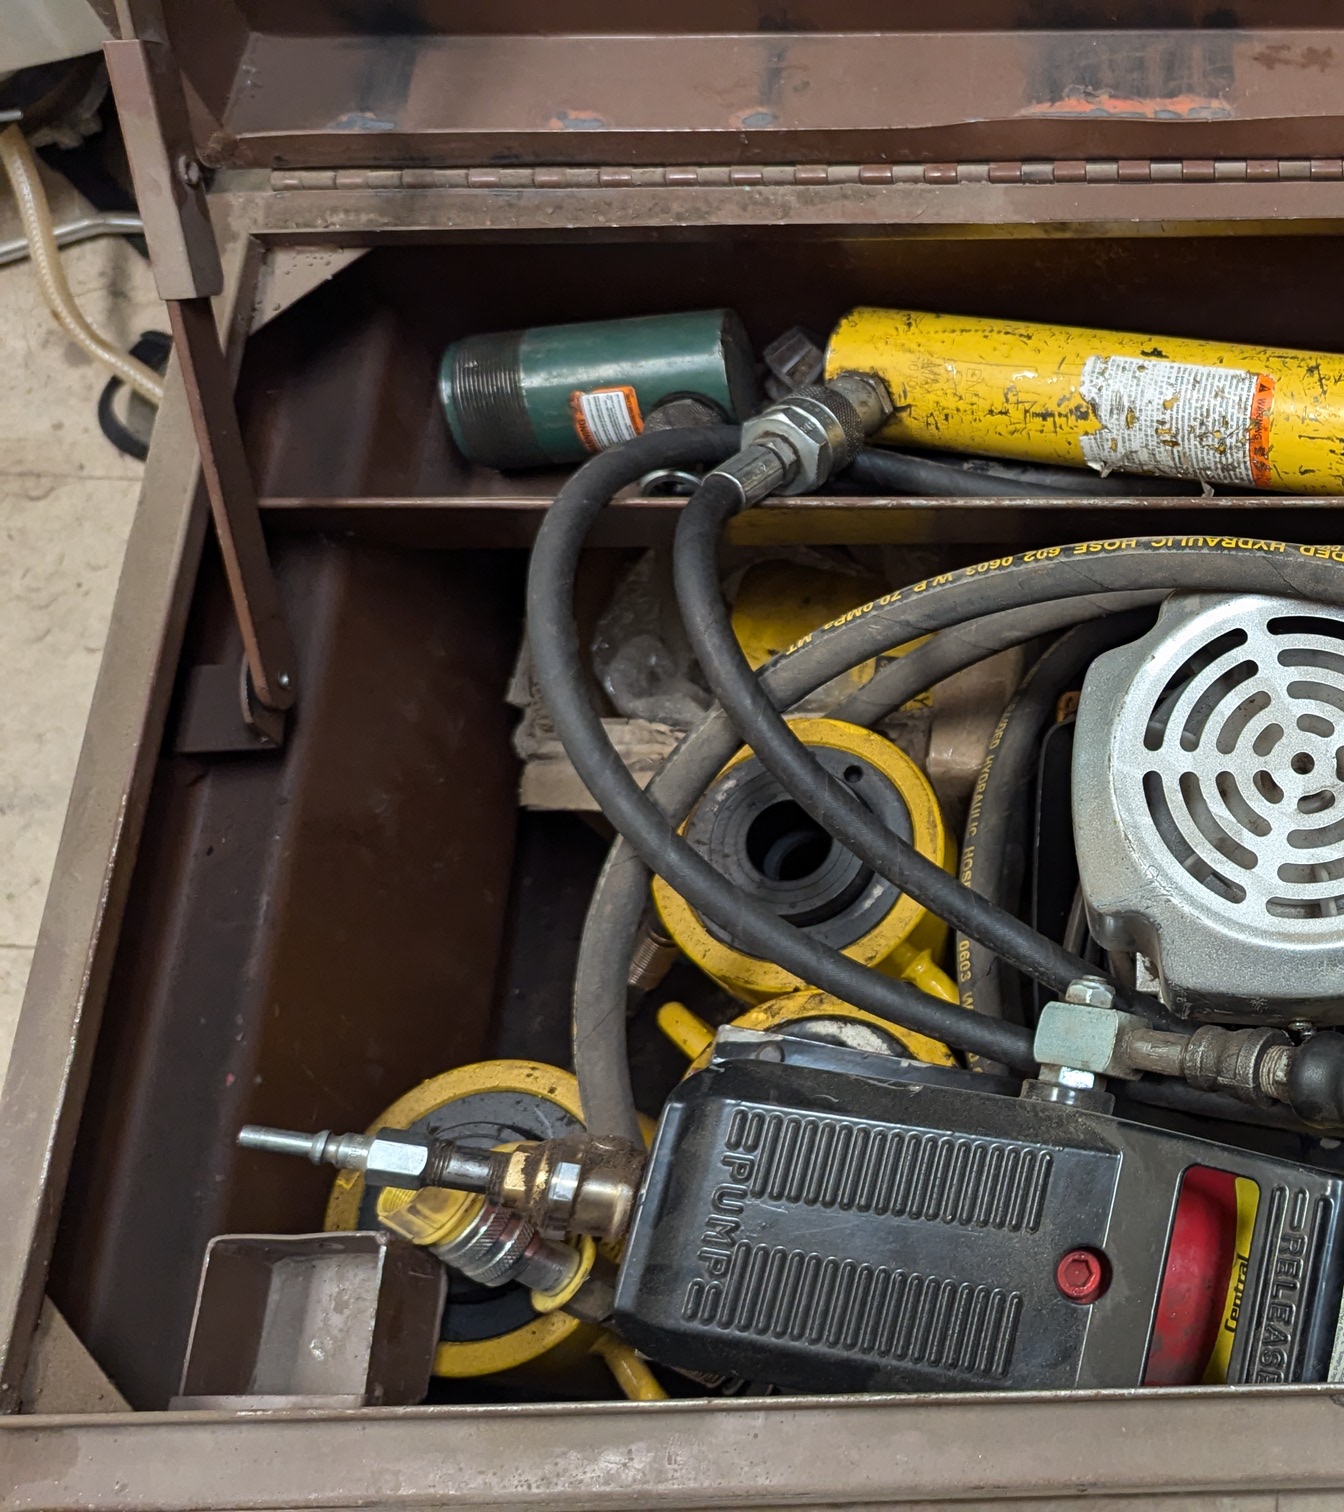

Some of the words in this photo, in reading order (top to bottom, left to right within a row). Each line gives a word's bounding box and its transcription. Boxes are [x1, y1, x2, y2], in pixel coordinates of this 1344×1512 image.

[966, 554, 1014, 577] 0603
[1024, 546, 1061, 562] 602
[1073, 537, 1137, 556] HOSE
[1151, 536, 1286, 555] HYDRAULIC
[965, 754, 995, 837] HYDRAULIC
[958, 939, 973, 983] 0603
[697, 1153, 755, 1279] PUMP
[1224, 1253, 1250, 1334] Central
[1257, 1233, 1307, 1382] RELEASE
